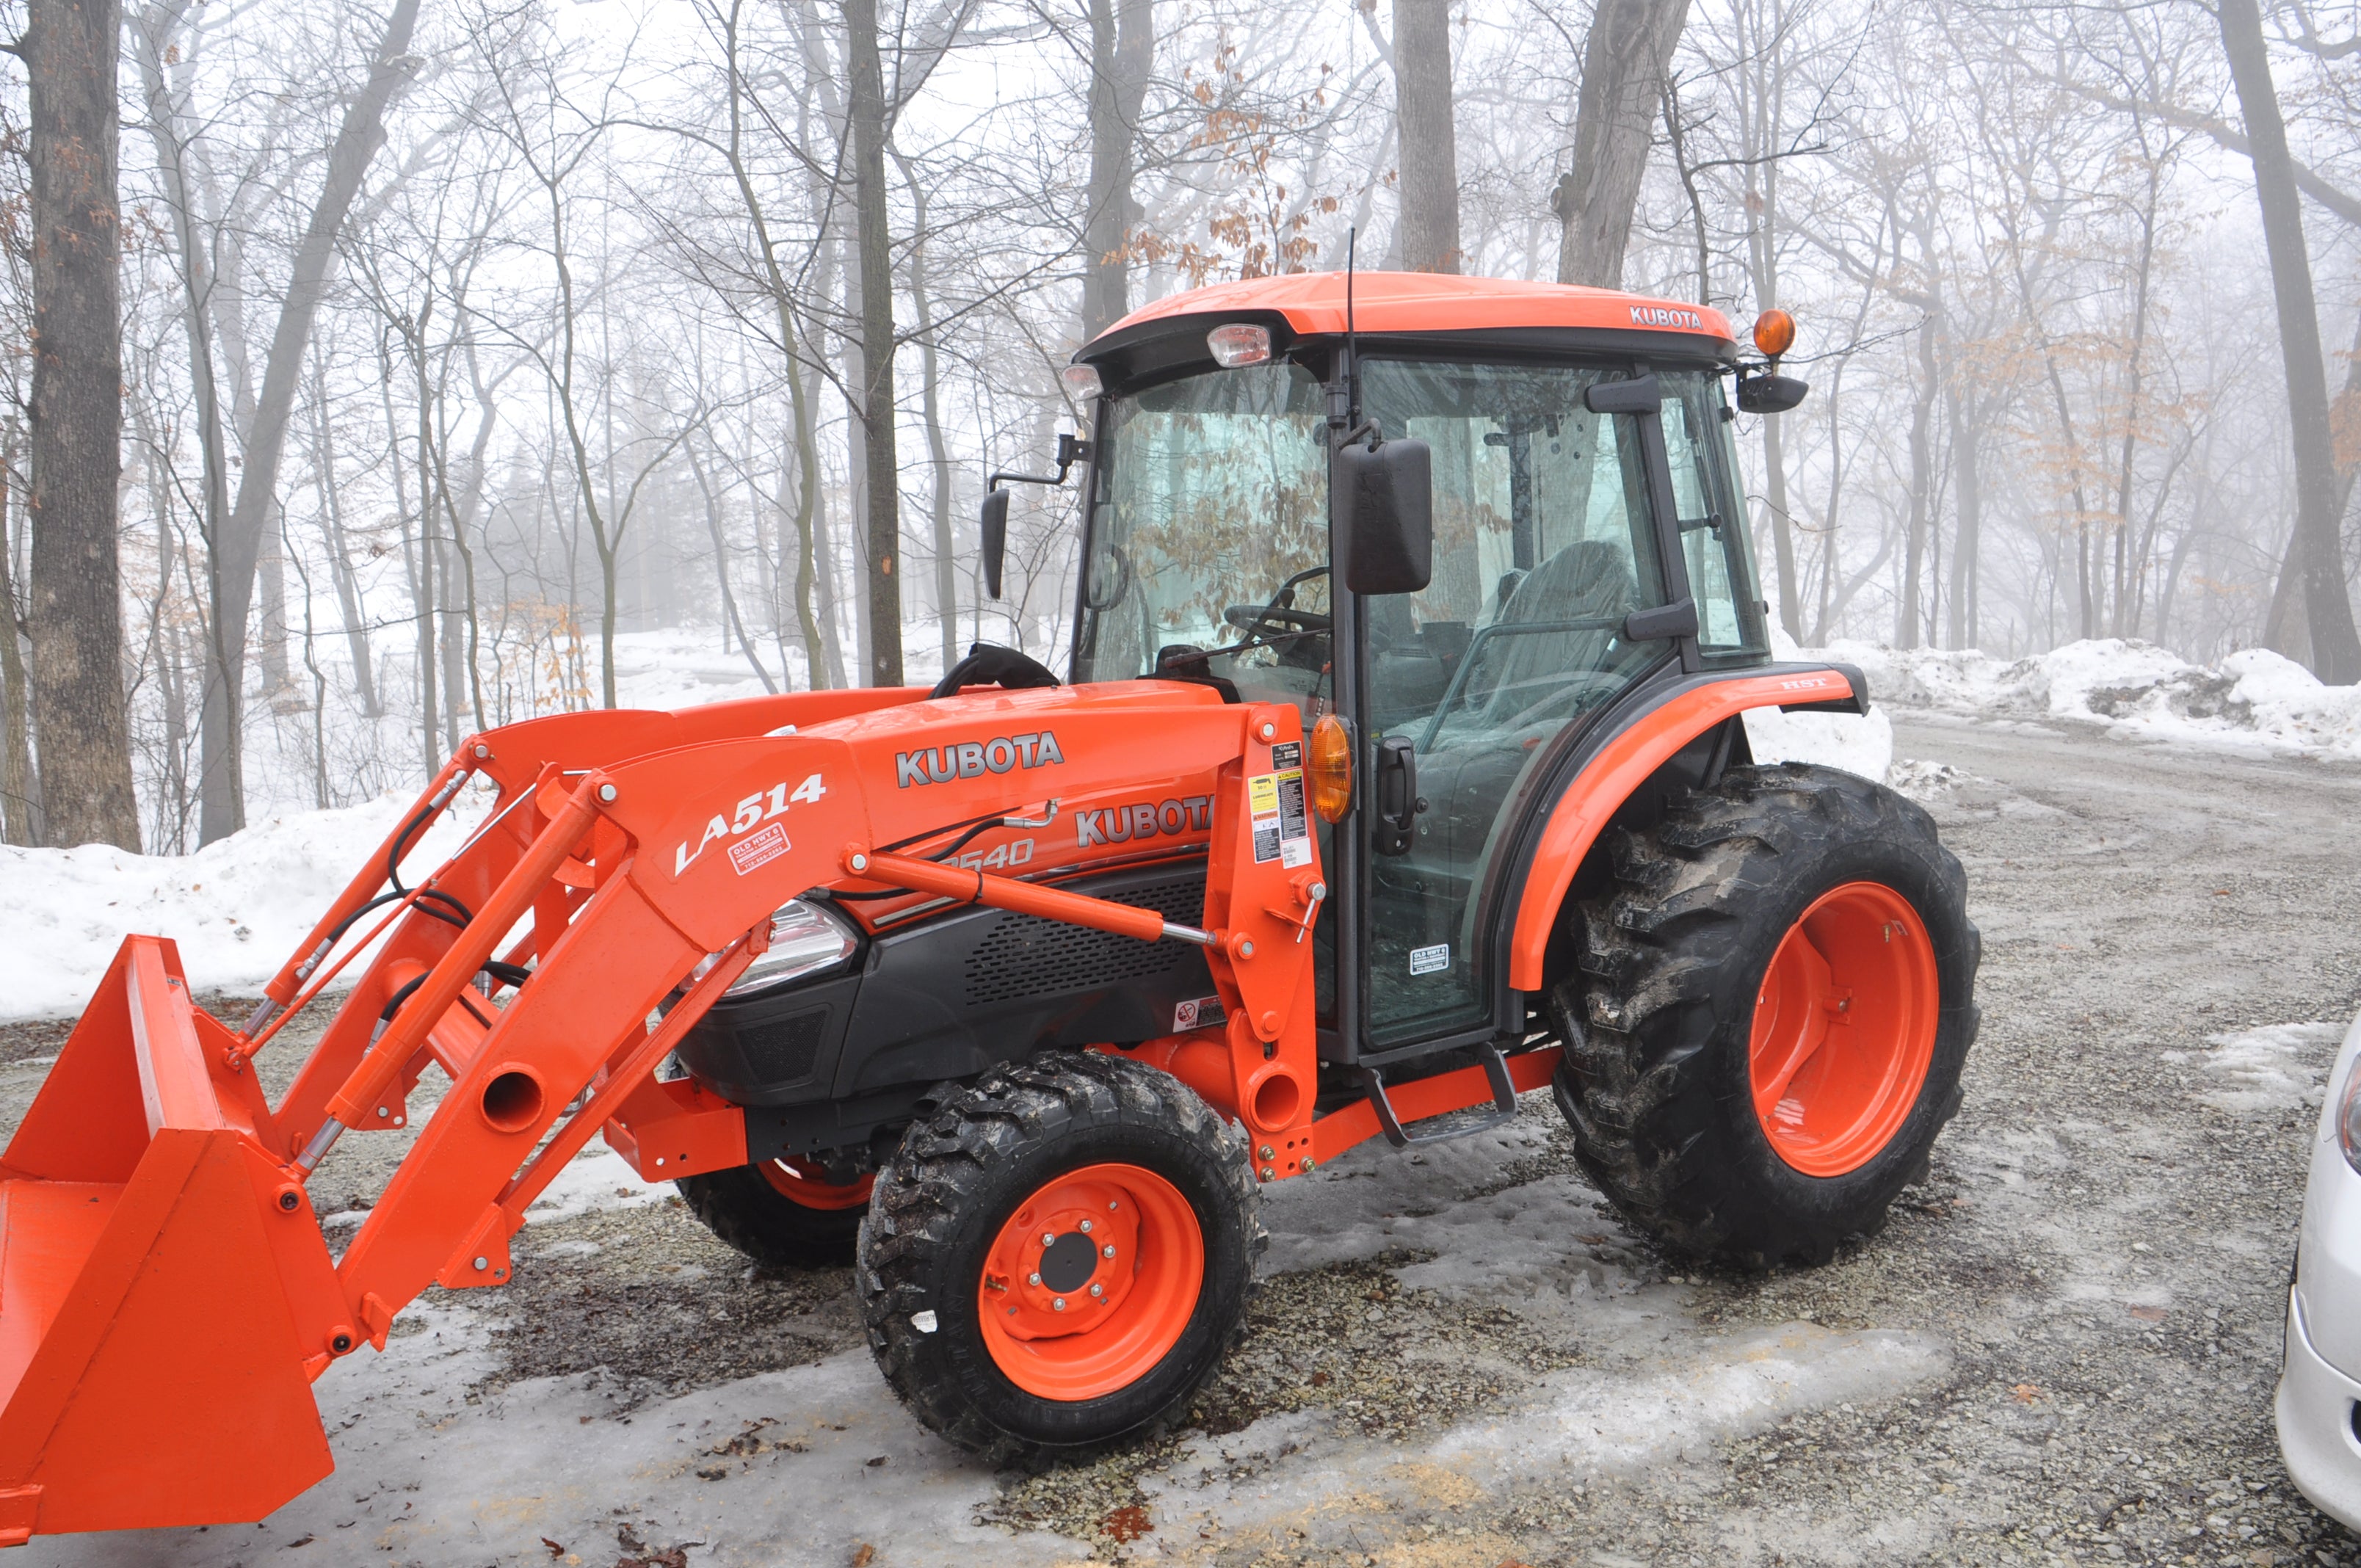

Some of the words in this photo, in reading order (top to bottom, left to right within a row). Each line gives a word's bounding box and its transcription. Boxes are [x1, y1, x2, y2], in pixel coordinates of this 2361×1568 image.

[1629, 305, 1703, 330] KUBOTA
[1780, 678, 1827, 690] HST
[895, 730, 1065, 788] KUBOTA
[675, 773, 827, 876] LA514
[733, 843, 751, 855] OLD
[752, 831, 772, 846] HWY
